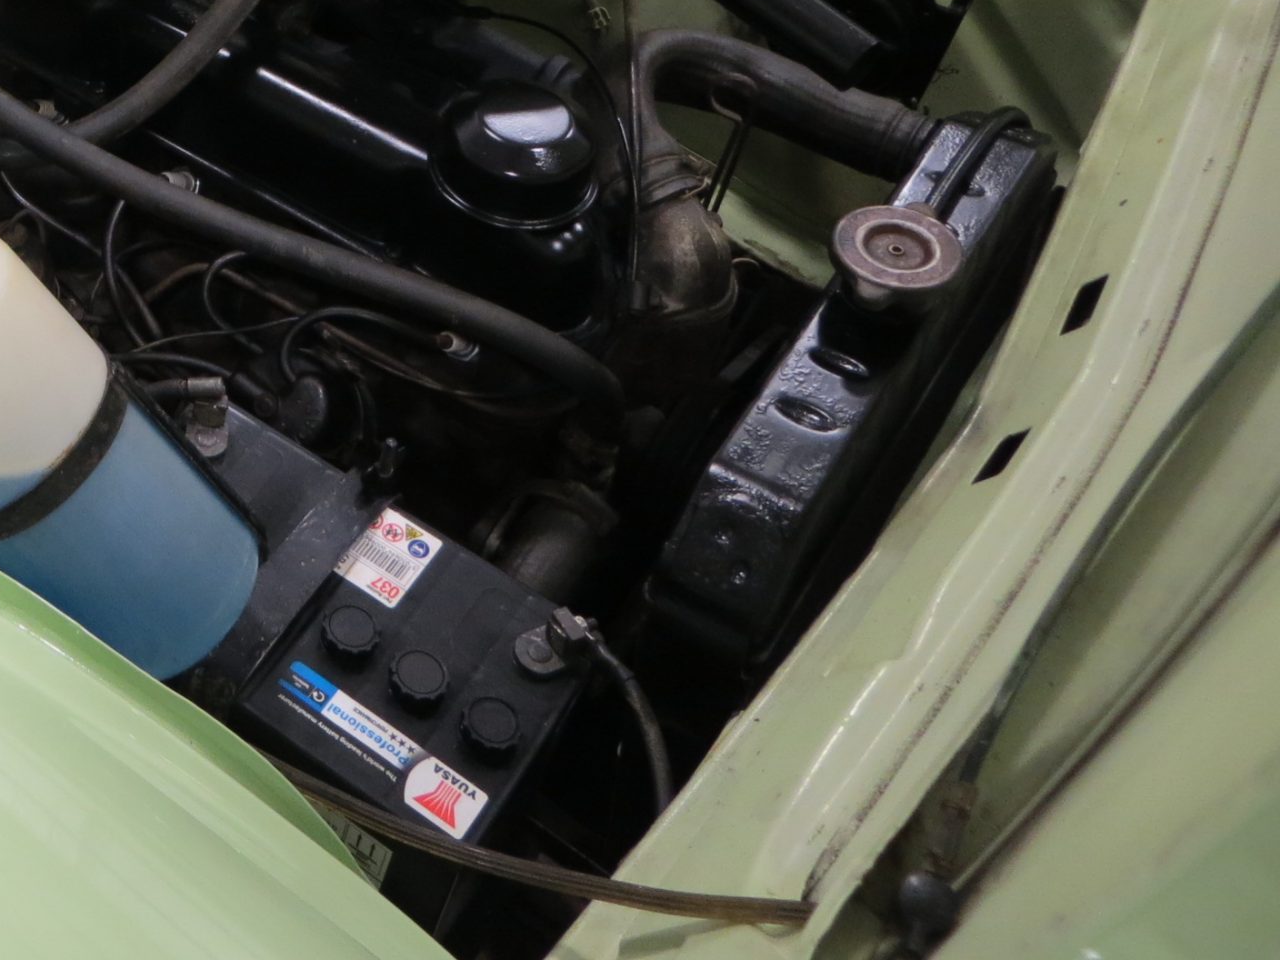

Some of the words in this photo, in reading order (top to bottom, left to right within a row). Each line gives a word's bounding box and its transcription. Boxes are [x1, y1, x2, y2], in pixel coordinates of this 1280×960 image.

[371, 576, 400, 599] 037
[276, 691, 318, 724] manufacturer
[316, 720, 340, 740] battery
[325, 702, 410, 766] Professional
[337, 735, 364, 756] leading
[383, 769, 398, 782] The
[430, 762, 479, 800] YUASA
